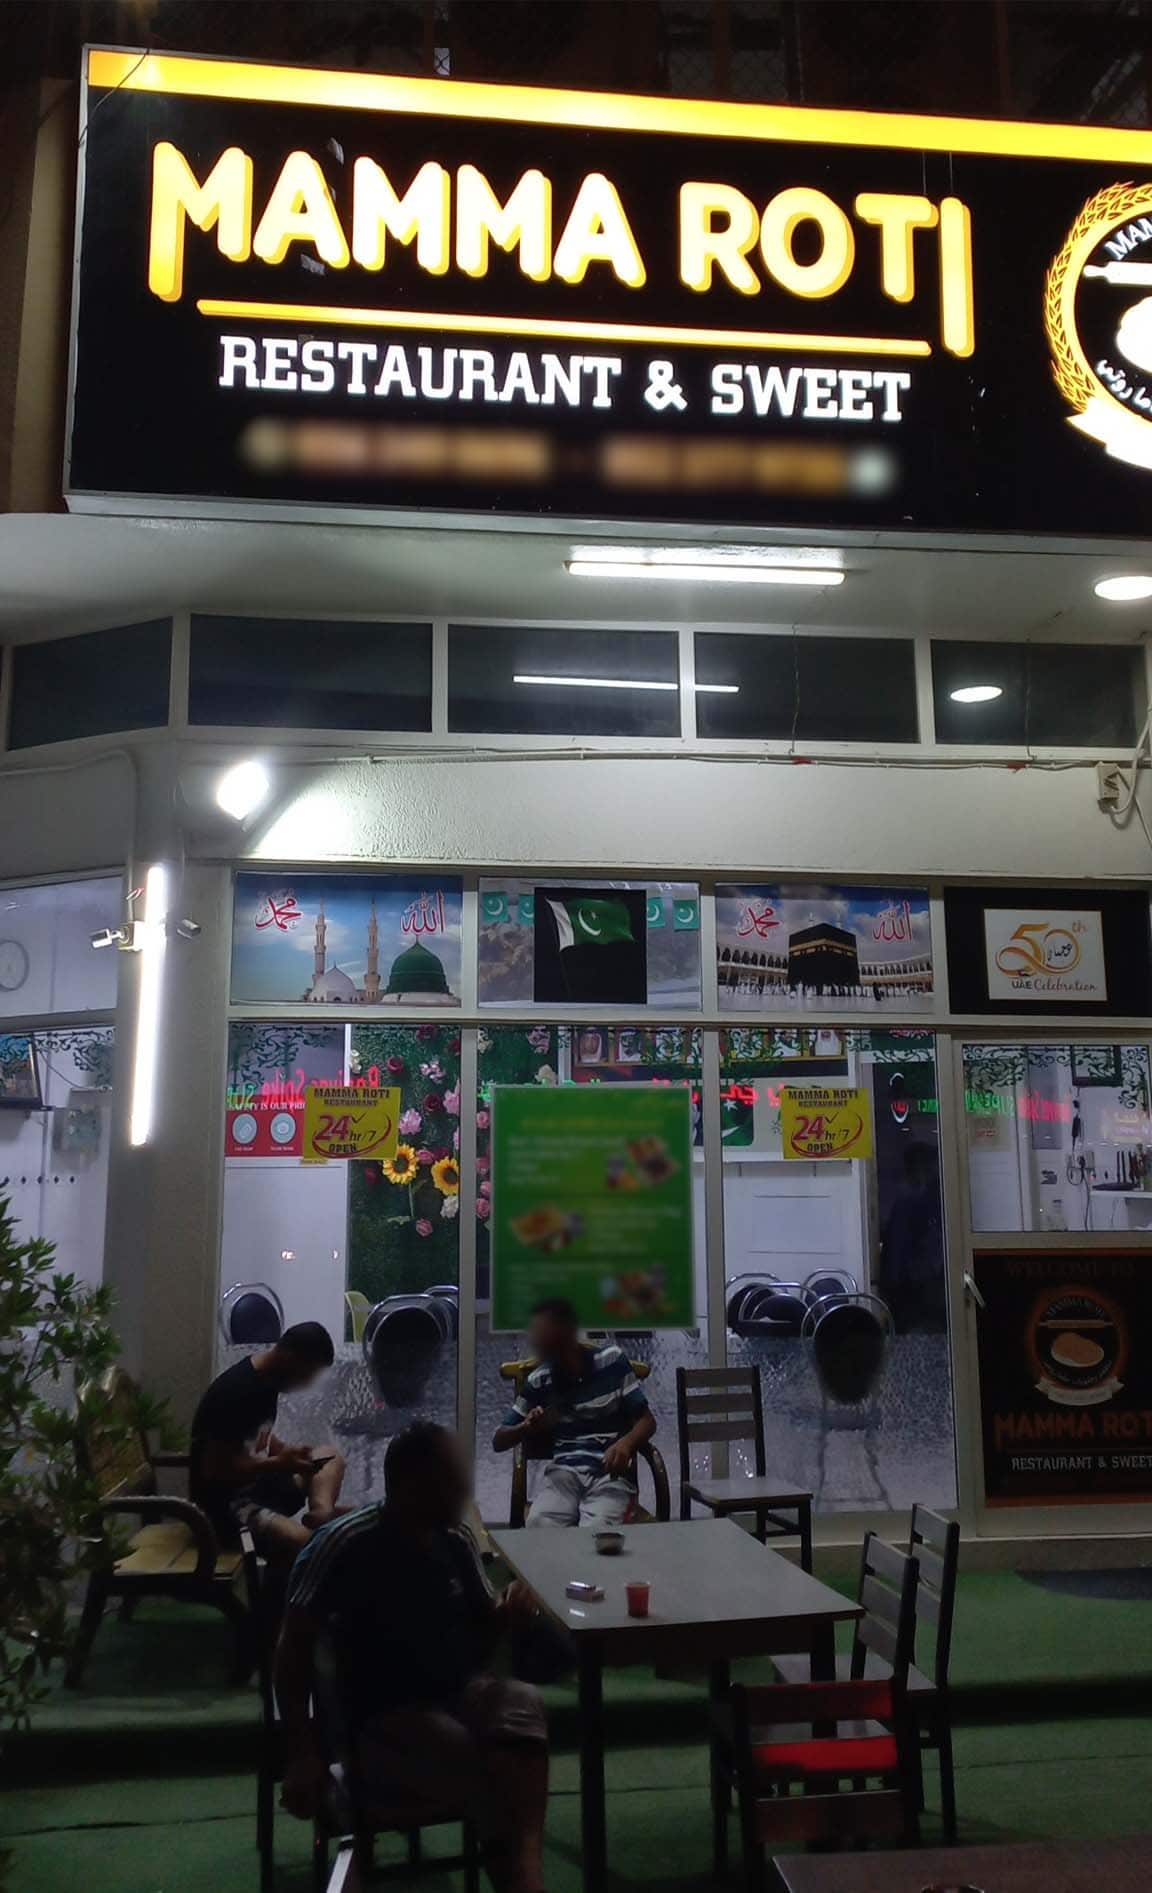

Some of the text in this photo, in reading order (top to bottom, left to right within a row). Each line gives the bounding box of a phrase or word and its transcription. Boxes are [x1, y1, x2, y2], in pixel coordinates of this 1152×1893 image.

[148, 141, 974, 358] MAMMA ROTI
[218, 335, 911, 423] RESTAURANT & SWEET
[1033, 977, 1099, 992] Celebration
[315, 1113, 352, 1141] 24
[793, 1114, 825, 1141] 24
[993, 1410, 1095, 1450] MAMMA
[1011, 1456, 1092, 1471] RESTAURANT
